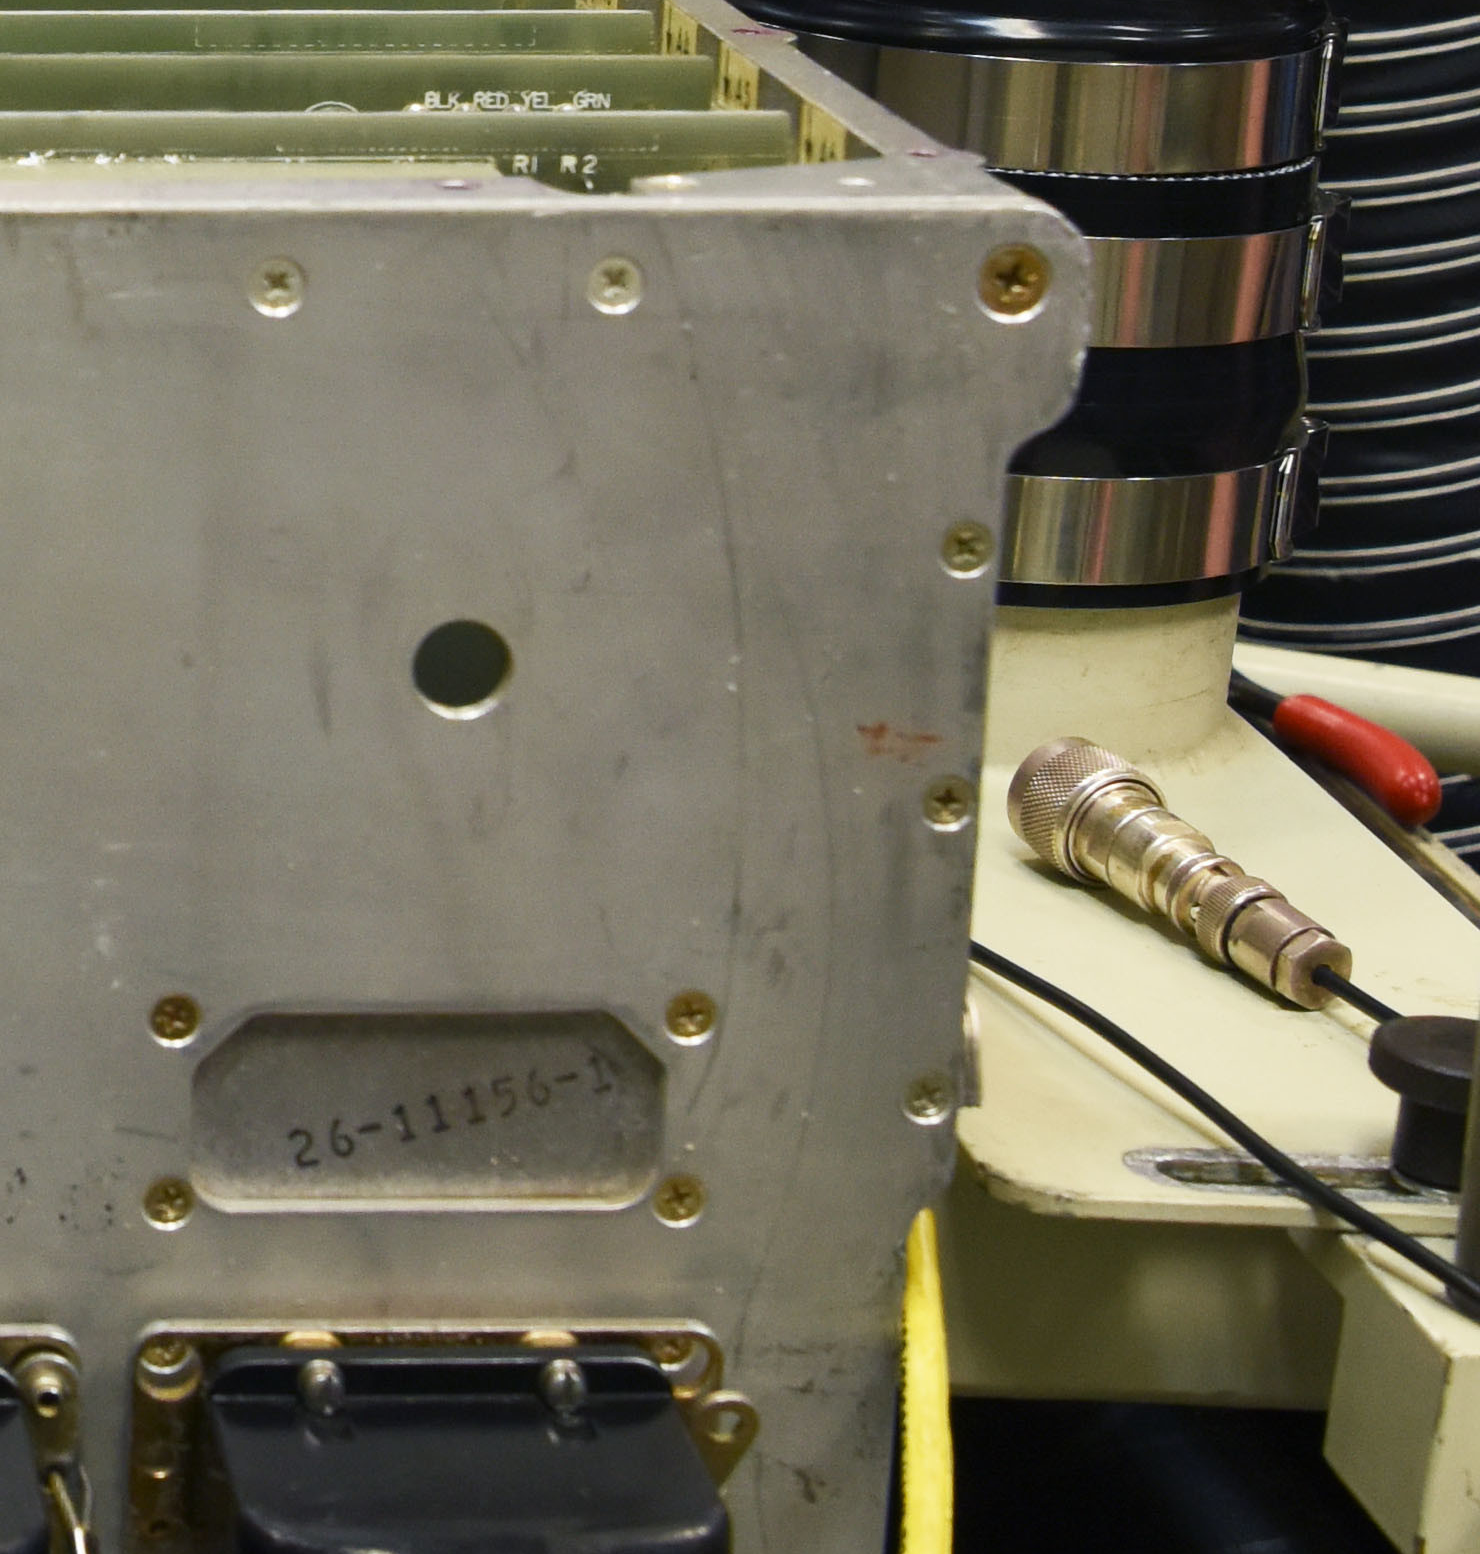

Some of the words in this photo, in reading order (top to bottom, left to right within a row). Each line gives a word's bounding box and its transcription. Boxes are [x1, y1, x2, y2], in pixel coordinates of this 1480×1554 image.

[424, 92, 461, 109] BLK
[473, 92, 510, 109] RED
[521, 92, 550, 109] YEL
[572, 92, 612, 110] GRN
[512, 154, 538, 174] R1
[560, 154, 598, 175] R2
